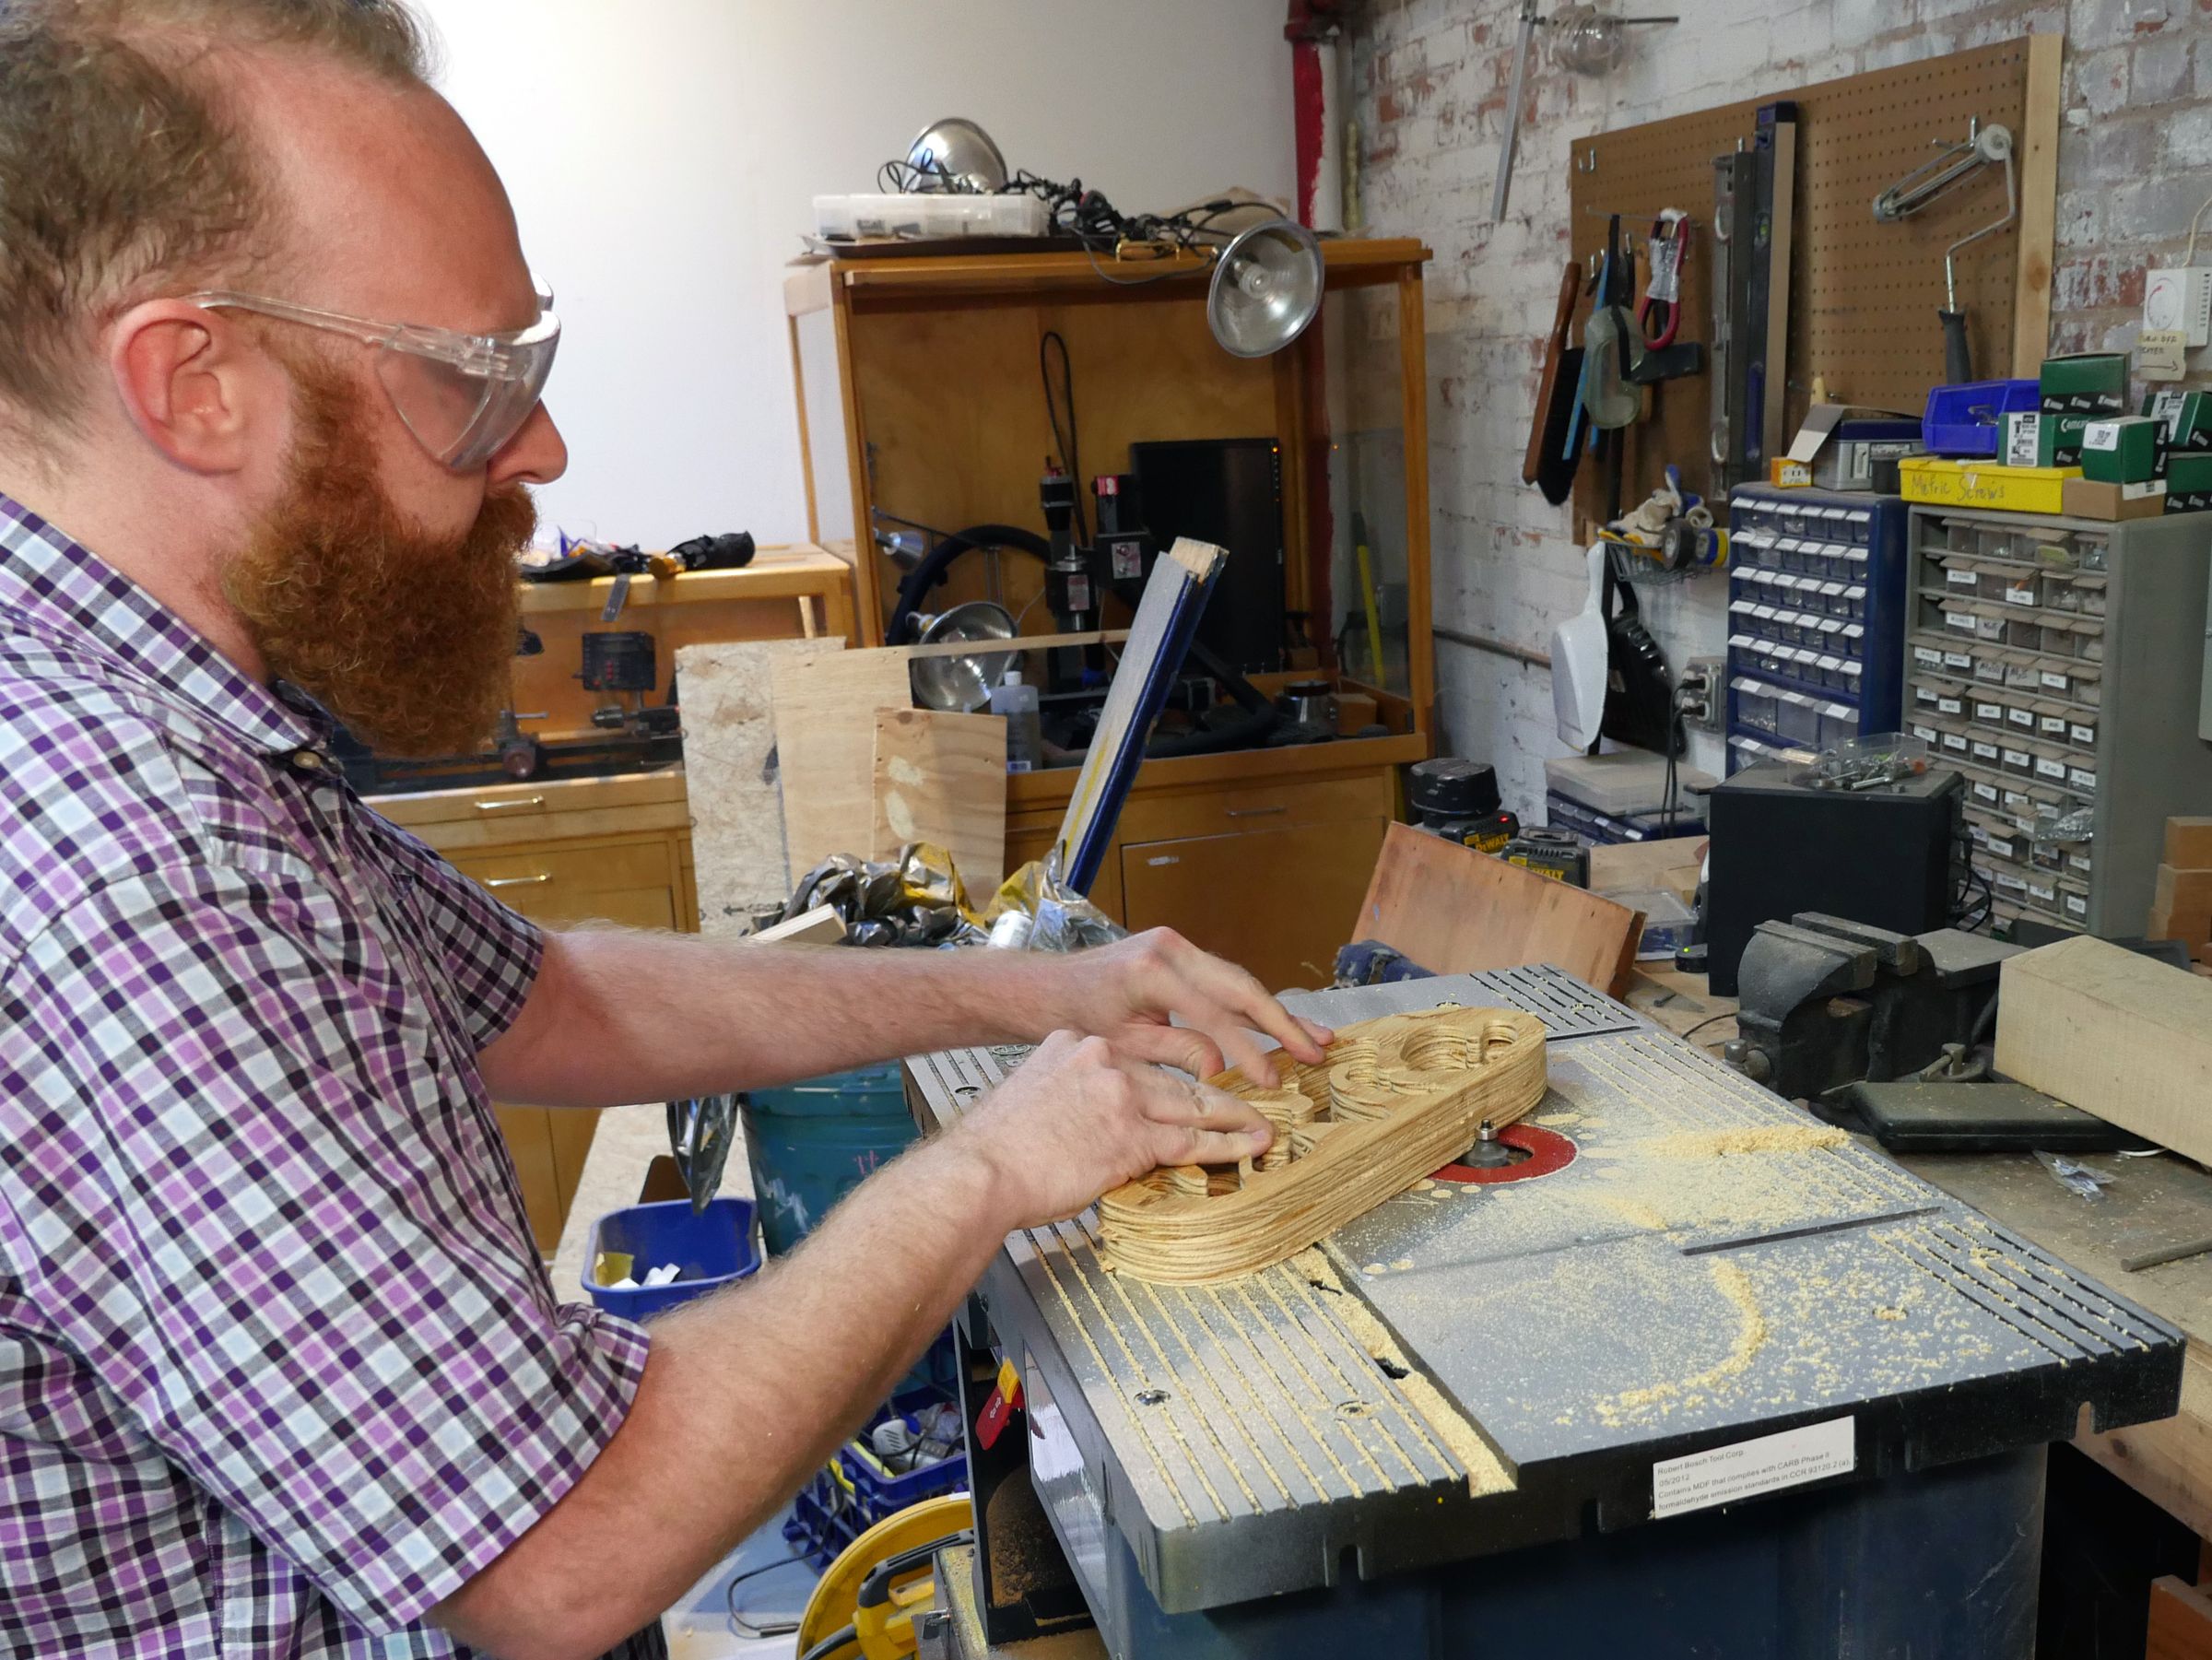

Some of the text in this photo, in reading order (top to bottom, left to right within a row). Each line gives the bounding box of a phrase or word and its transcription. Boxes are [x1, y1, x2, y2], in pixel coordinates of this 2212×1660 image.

[1911, 473, 2006, 501] Metric Screws
[1657, 1464, 1683, 1476] Robert
[1684, 1458, 1708, 1469] Bosch
[1710, 1453, 1724, 1463] Tool
[1658, 1485, 1691, 1499] Contains
[1692, 1481, 1710, 1490] MDF
[1712, 1477, 1726, 1487] that
[1726, 1468, 1759, 1483] complies
[1760, 1465, 1776, 1474] with
[1777, 1459, 1799, 1470] CARB
[1801, 1454, 1824, 1464] Phase
[1658, 1494, 1710, 1511] formaldehyde
[1710, 1486, 1743, 1499] emission
[1744, 1476, 1780, 1489] standards
[1789, 1469, 1806, 1478] CCR
